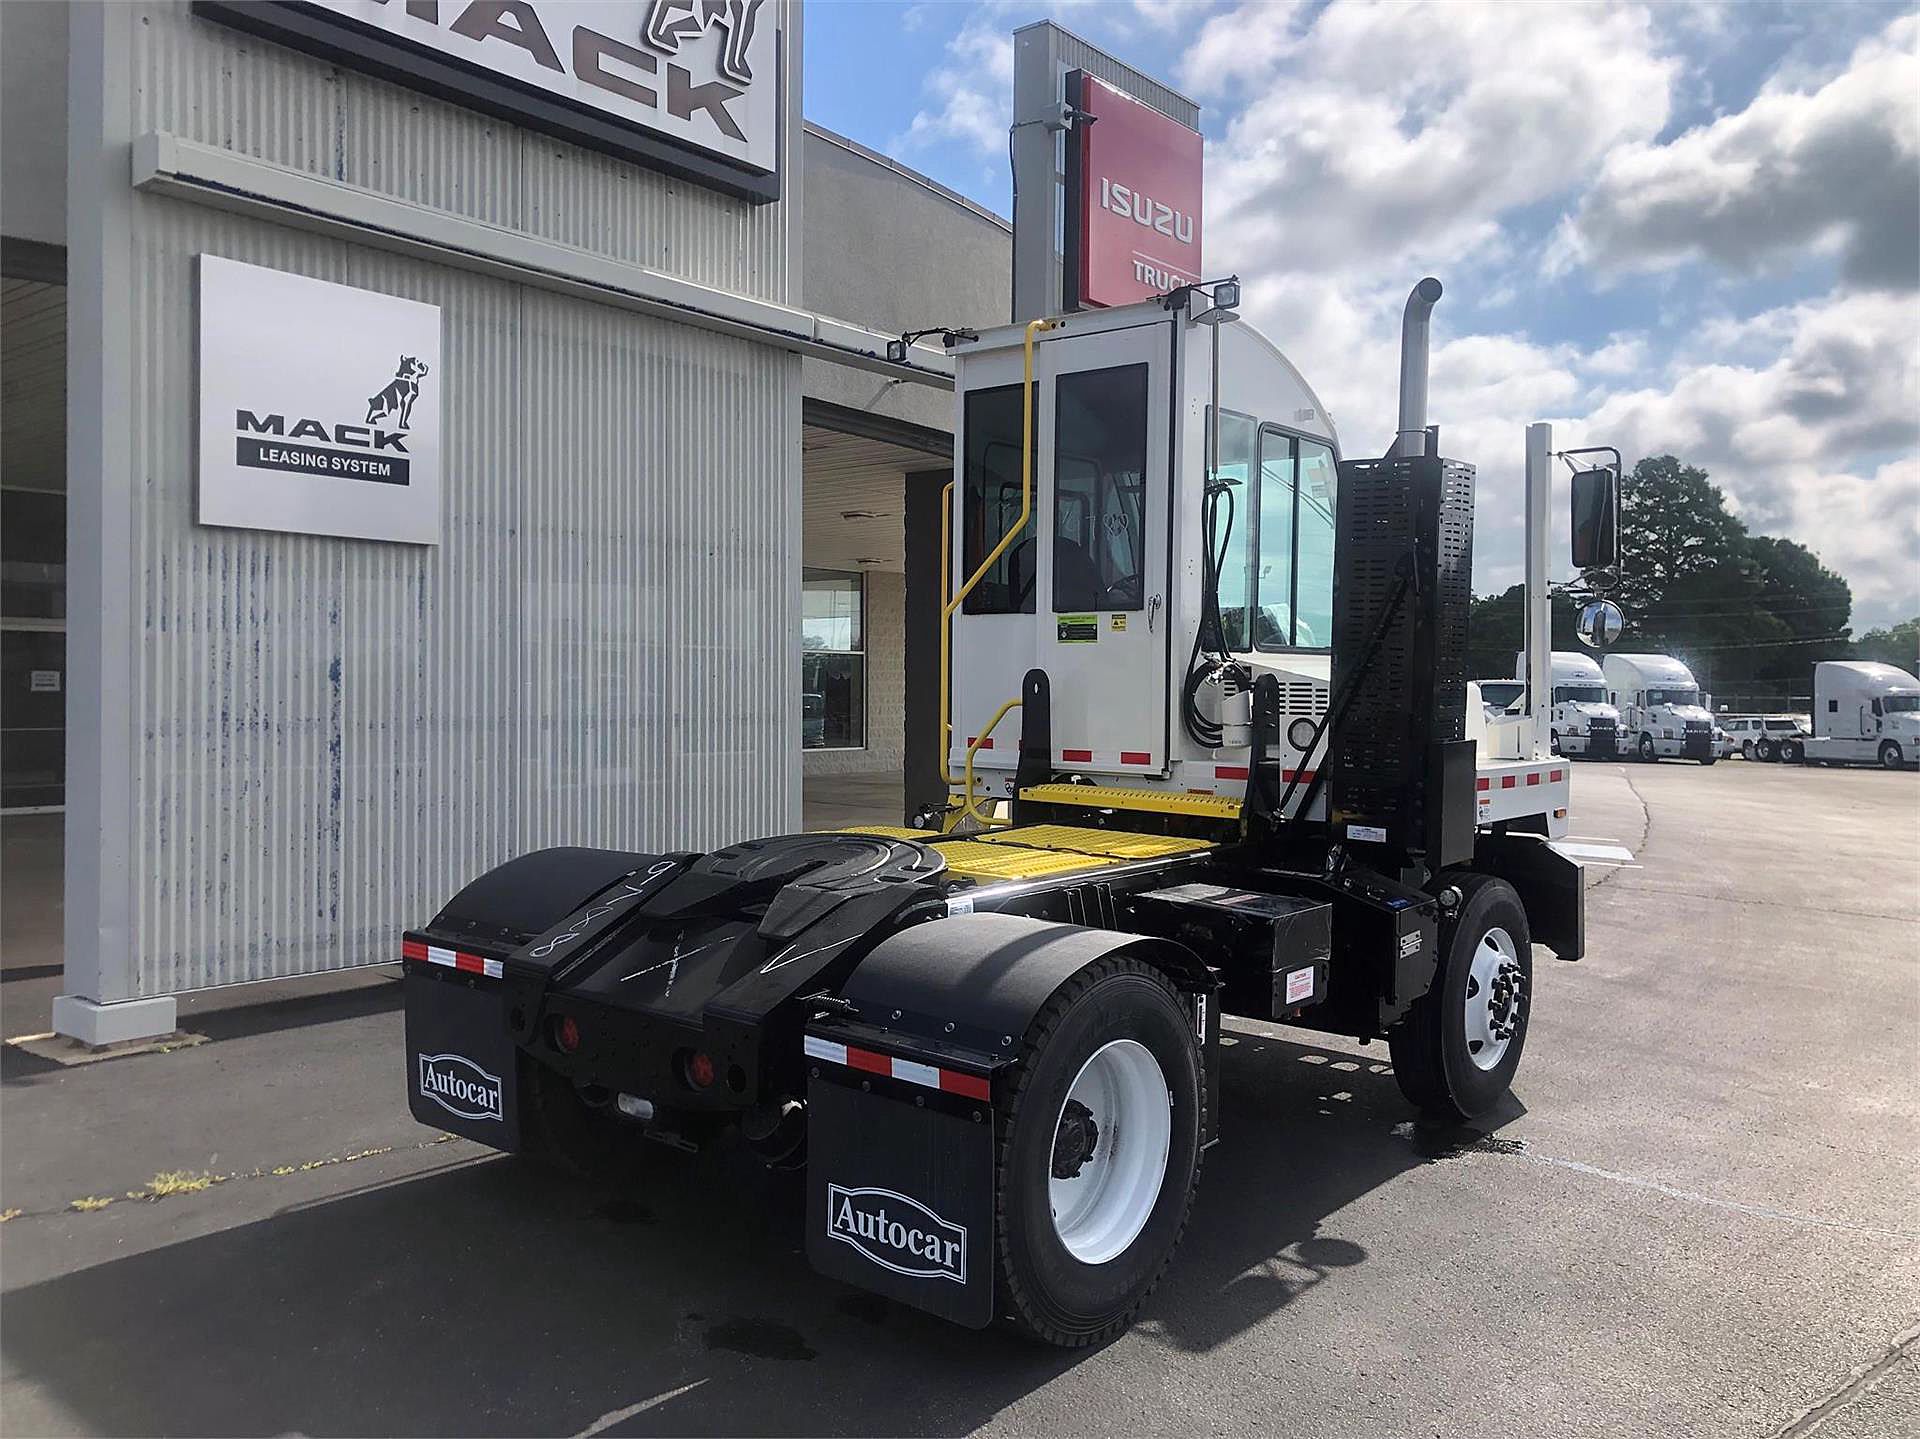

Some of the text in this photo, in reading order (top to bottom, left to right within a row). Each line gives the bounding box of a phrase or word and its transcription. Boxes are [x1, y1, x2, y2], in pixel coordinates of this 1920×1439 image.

[372, 0, 749, 143] ACK
[1101, 176, 1193, 244] ISUZU
[236, 409, 409, 453] MACK
[259, 447, 391, 477] LEASING SYSTEM
[424, 1063, 498, 1110] Autocar
[833, 1196, 960, 1268] Autocar
